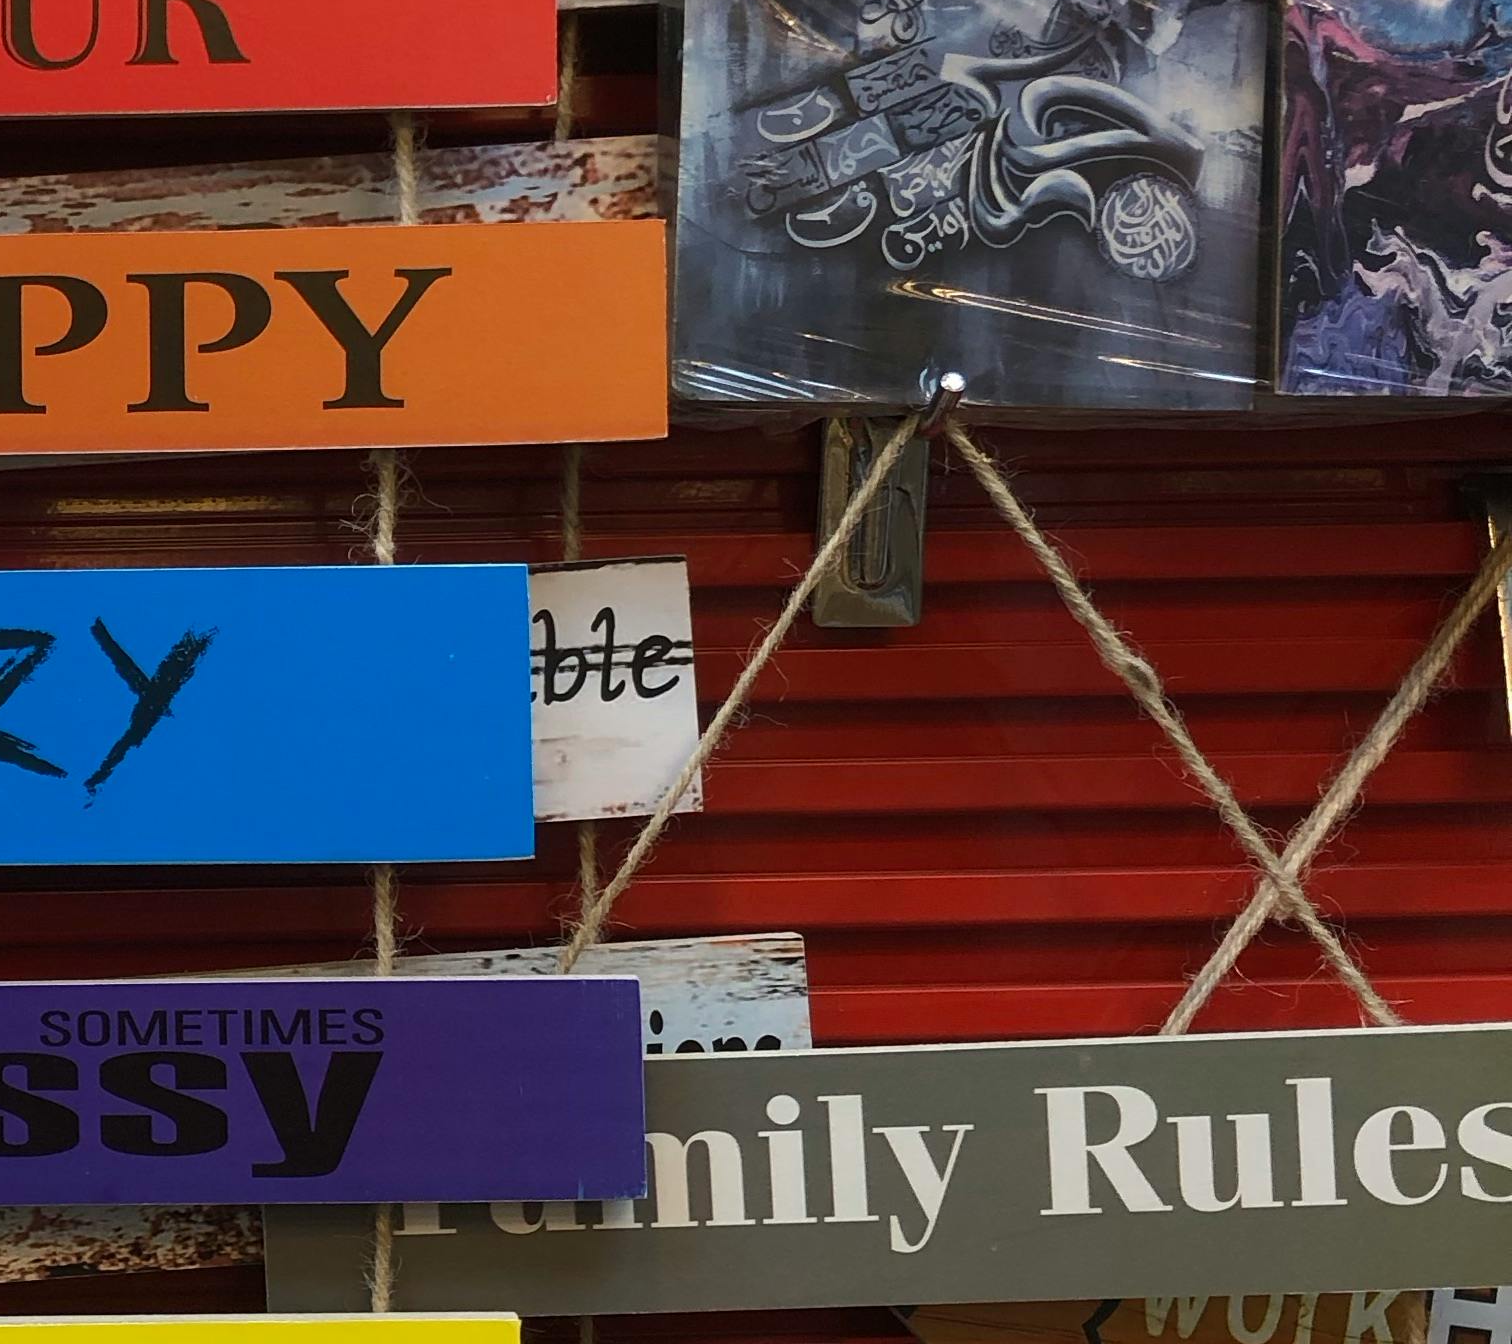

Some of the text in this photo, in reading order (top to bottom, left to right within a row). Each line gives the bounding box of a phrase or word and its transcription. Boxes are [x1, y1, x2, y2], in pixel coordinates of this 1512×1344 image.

[531, 606, 680, 705] ble
[40, 1008, 385, 1047] SOMETIMES
[393, 1077, 1512, 1254] mily Rules
